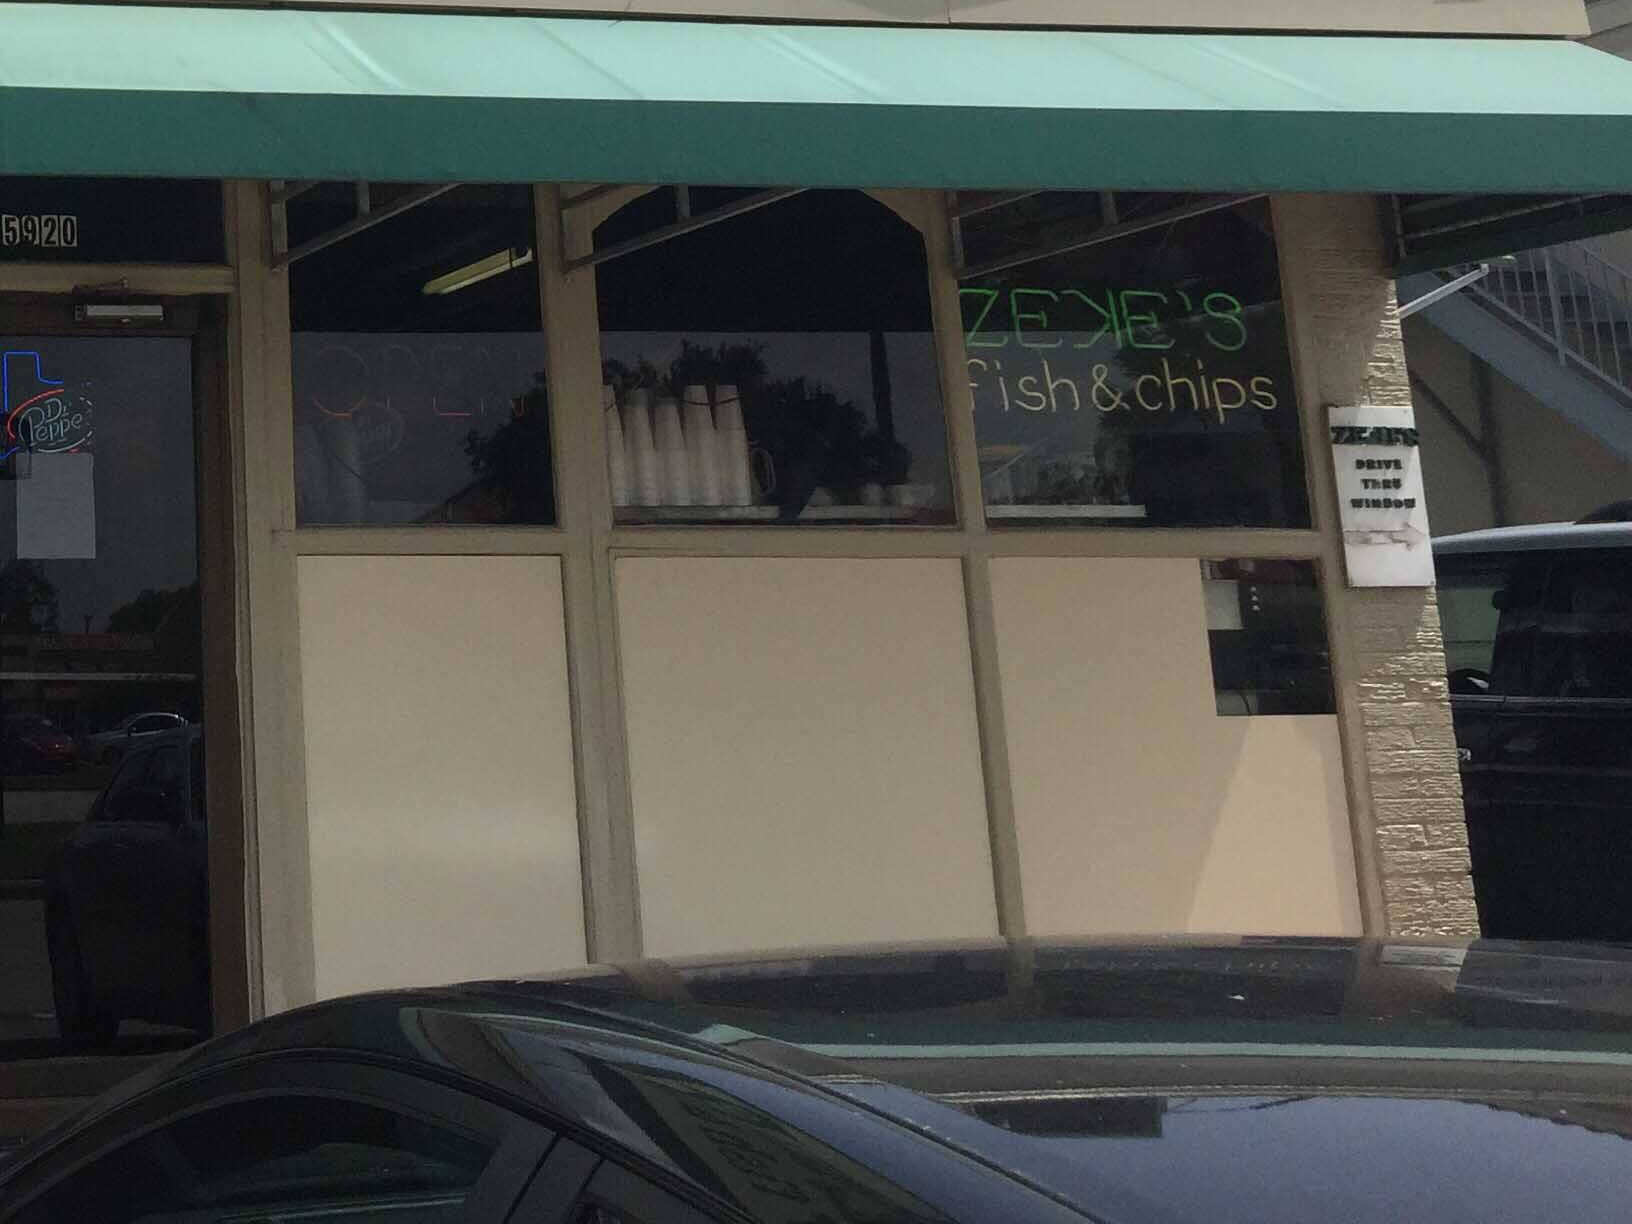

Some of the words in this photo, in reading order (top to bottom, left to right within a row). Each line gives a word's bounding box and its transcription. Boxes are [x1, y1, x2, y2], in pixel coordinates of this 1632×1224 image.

[1, 214, 78, 247] 5920
[959, 288, 1247, 352] ZEKE'S
[967, 358, 1081, 412] fish
[1091, 363, 1131, 412] &
[1135, 357, 1278, 425] chips
[19, 407, 85, 447] Peppe
[1355, 459, 1403, 471] DRIVE
[1350, 497, 1417, 510] WINDOW
